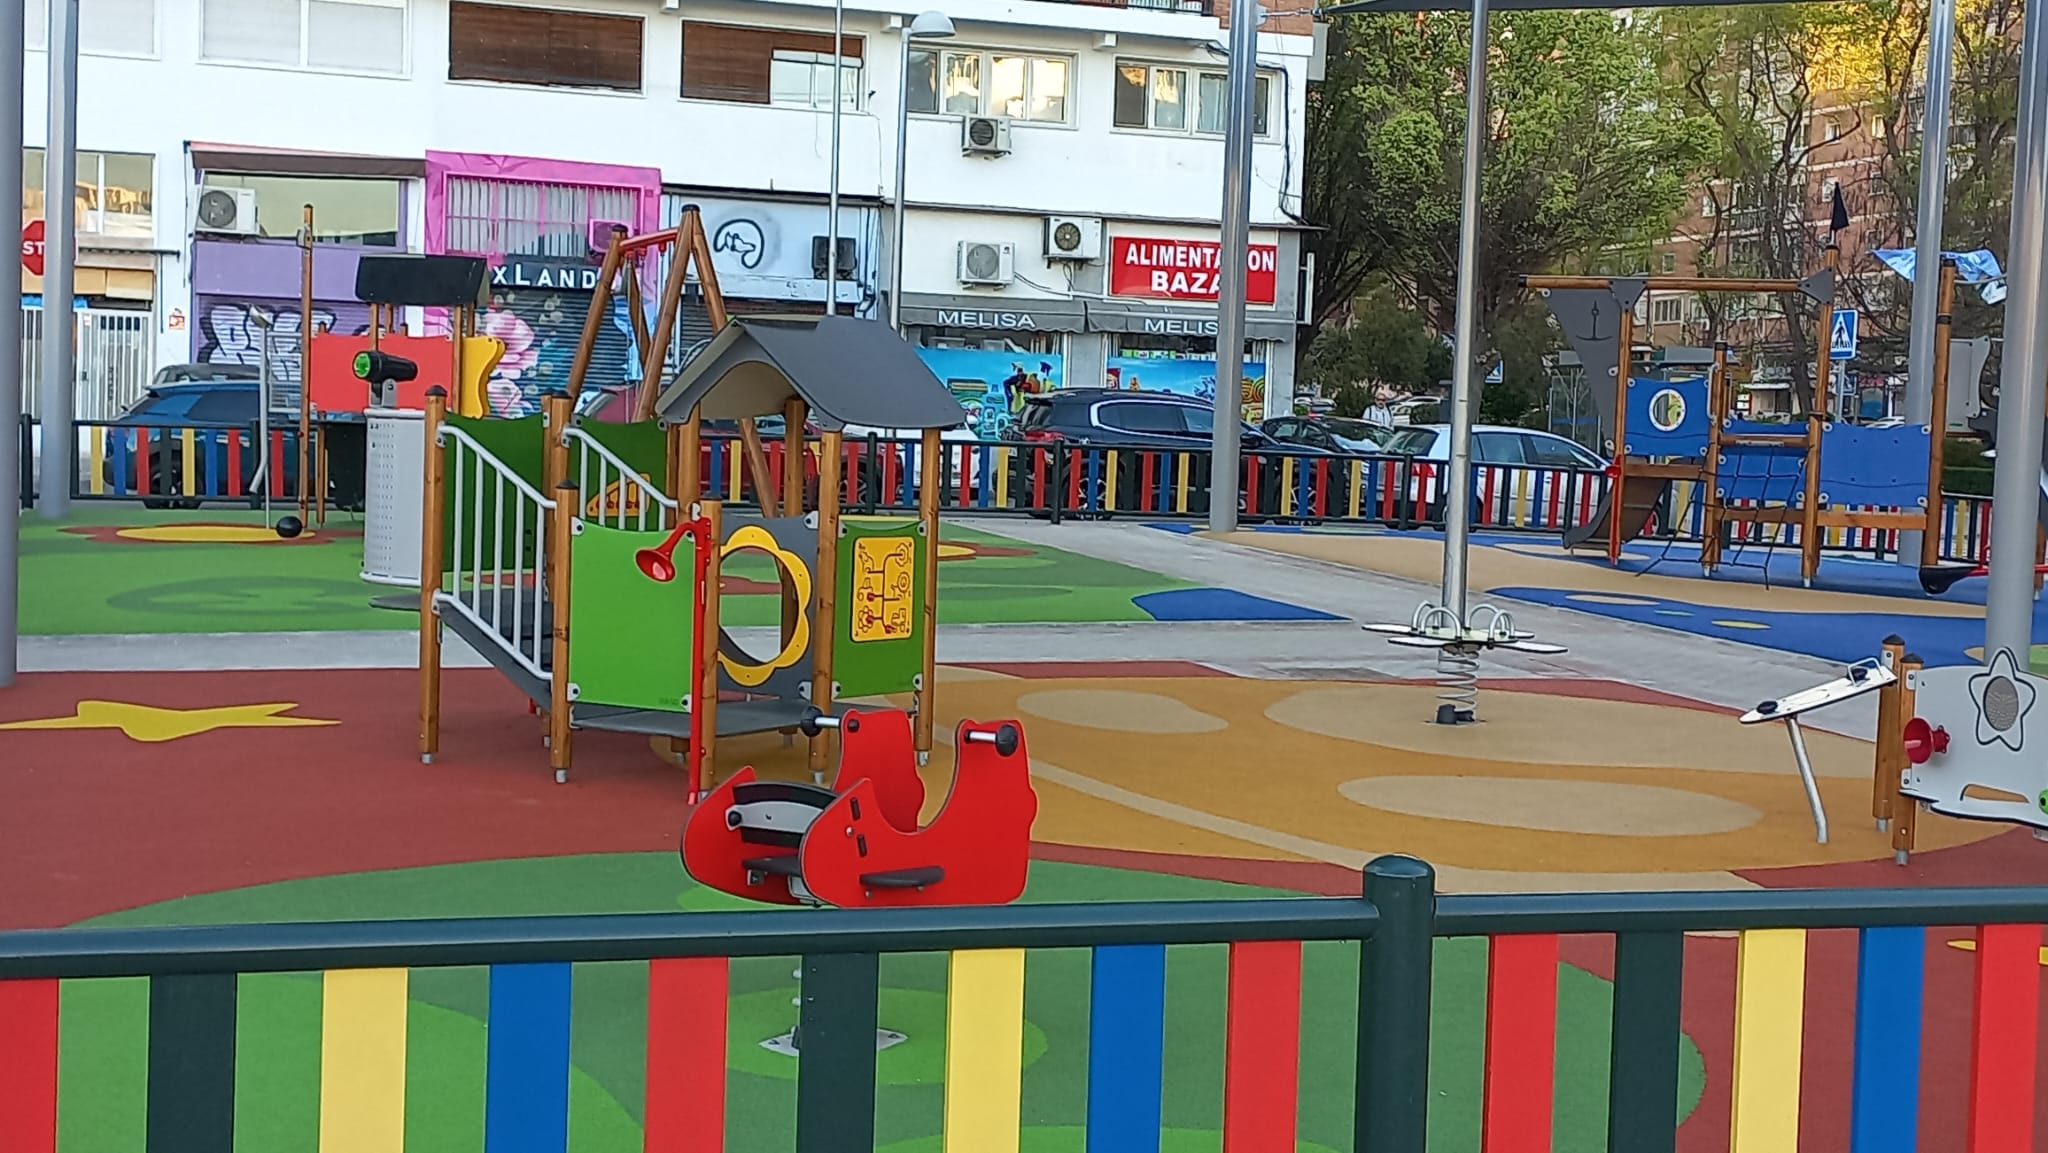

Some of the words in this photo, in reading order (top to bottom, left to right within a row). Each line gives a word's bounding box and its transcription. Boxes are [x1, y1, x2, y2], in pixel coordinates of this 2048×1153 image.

[22, 240, 46, 255] ST
[1125, 243, 1275, 272] ALIMENTAON
[1151, 270, 1220, 294] BAZA
[938, 310, 1036, 328] MELISA
[1144, 318, 1218, 335] MELIS
